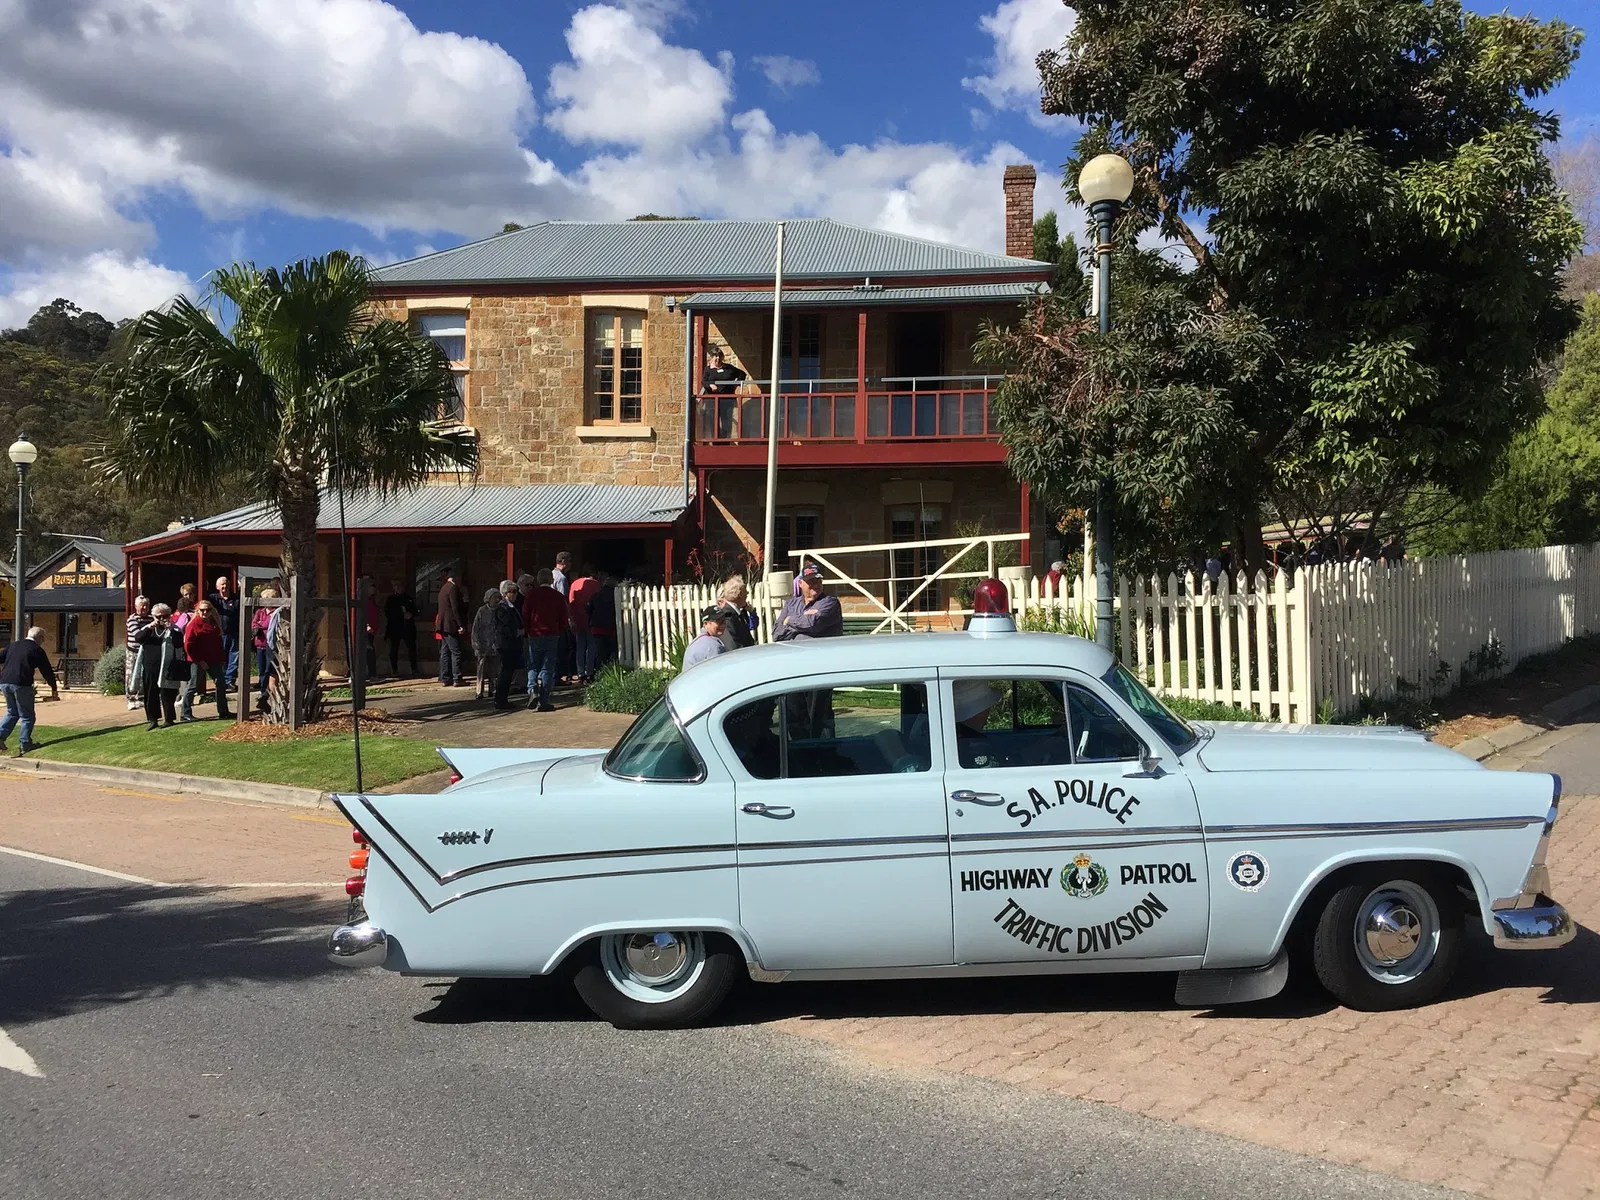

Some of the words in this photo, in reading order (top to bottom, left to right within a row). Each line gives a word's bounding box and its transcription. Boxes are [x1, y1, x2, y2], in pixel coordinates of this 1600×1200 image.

[78, 573, 102, 585] RAJA
[1054, 779, 1141, 825] POLICE
[961, 868, 1054, 891] HIGHWAY
[1120, 862, 1197, 885] PATROL
[993, 897, 1074, 954] TRAFFIC
[1076, 891, 1169, 954] DIVISION
